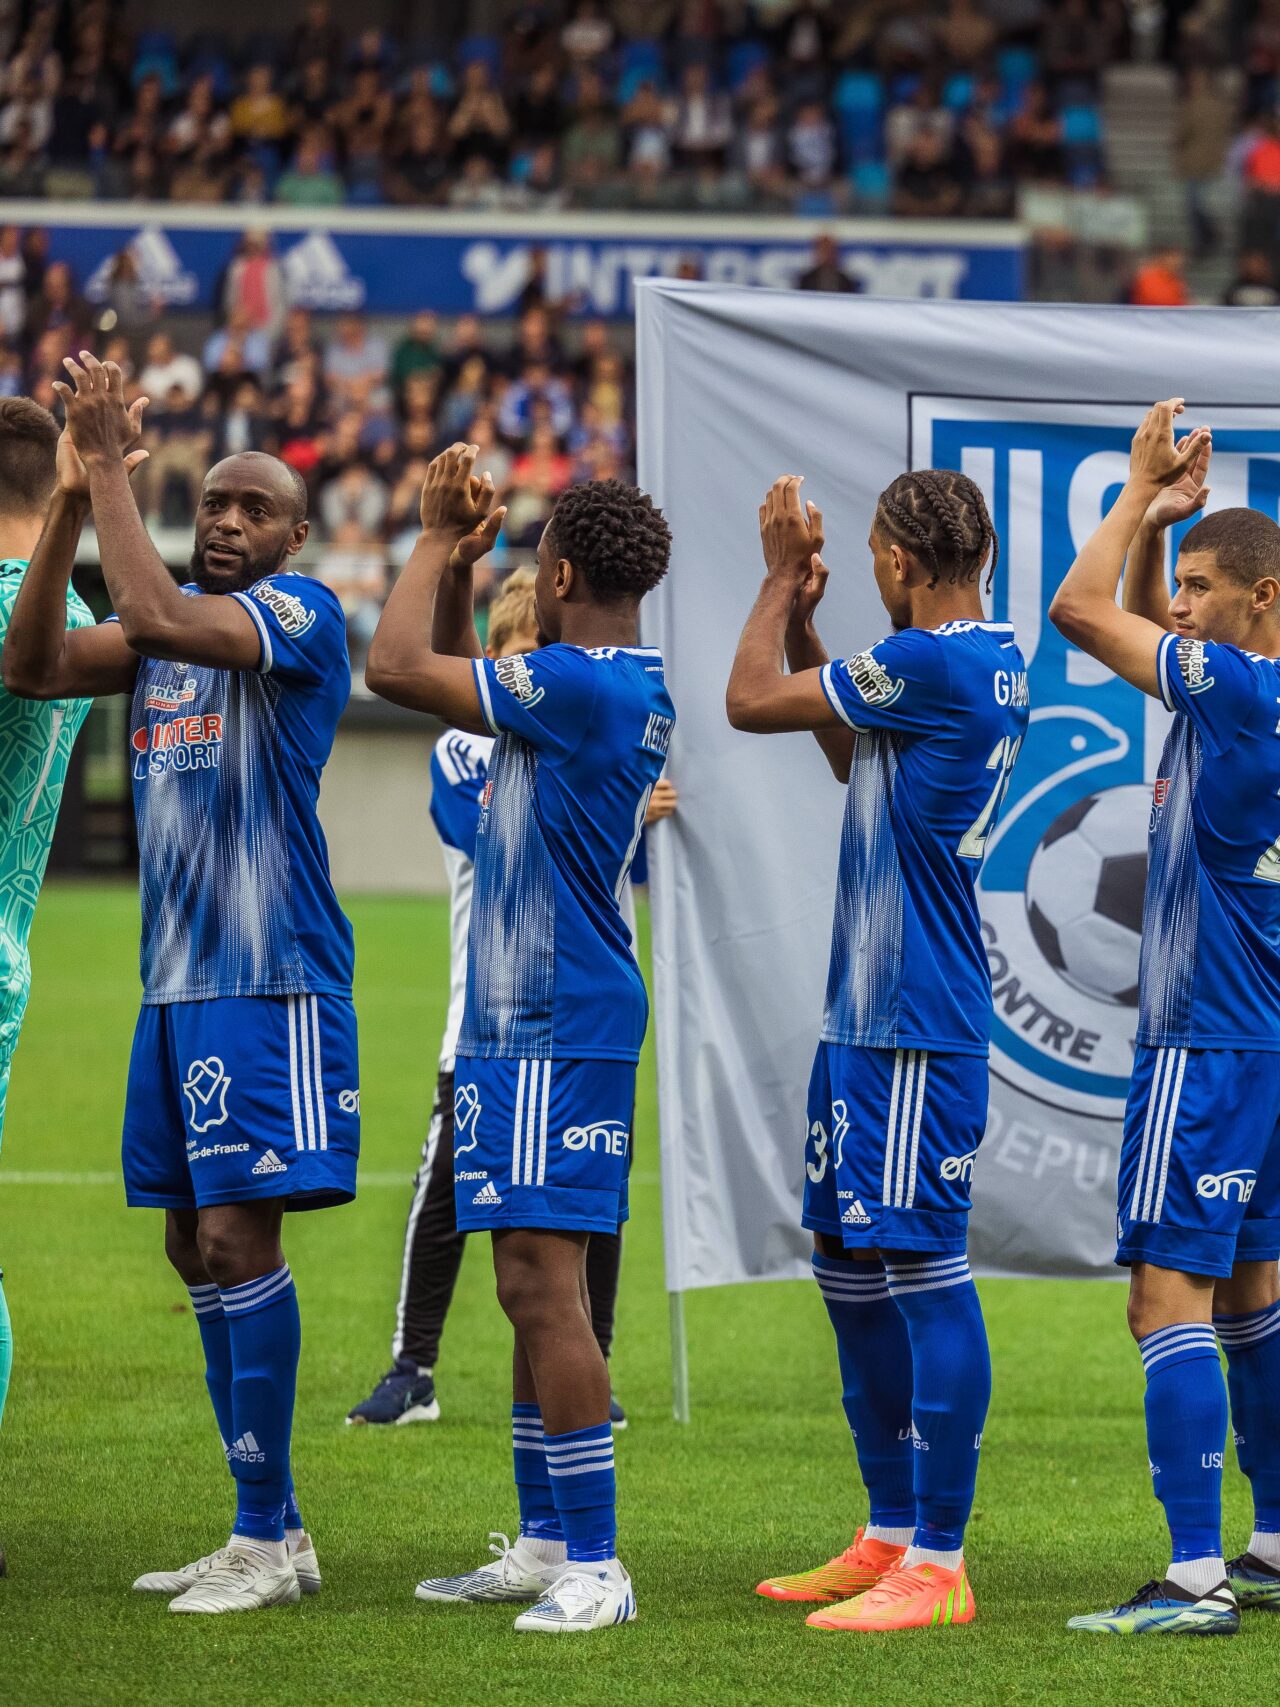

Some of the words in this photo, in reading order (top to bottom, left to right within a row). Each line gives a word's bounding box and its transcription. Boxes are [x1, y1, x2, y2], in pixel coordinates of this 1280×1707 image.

[254, 588, 300, 631] SPORT
[848, 653, 884, 702] SPORT
[152, 713, 222, 750] INTER
[148, 741, 222, 775] SPORT
[805, 1118, 828, 1184] 3
[251, 1162, 288, 1175] adidas
[472, 1195, 502, 1205] adidas
[841, 1214, 872, 1225] adidas
[1201, 1452, 1224, 1469] USL
